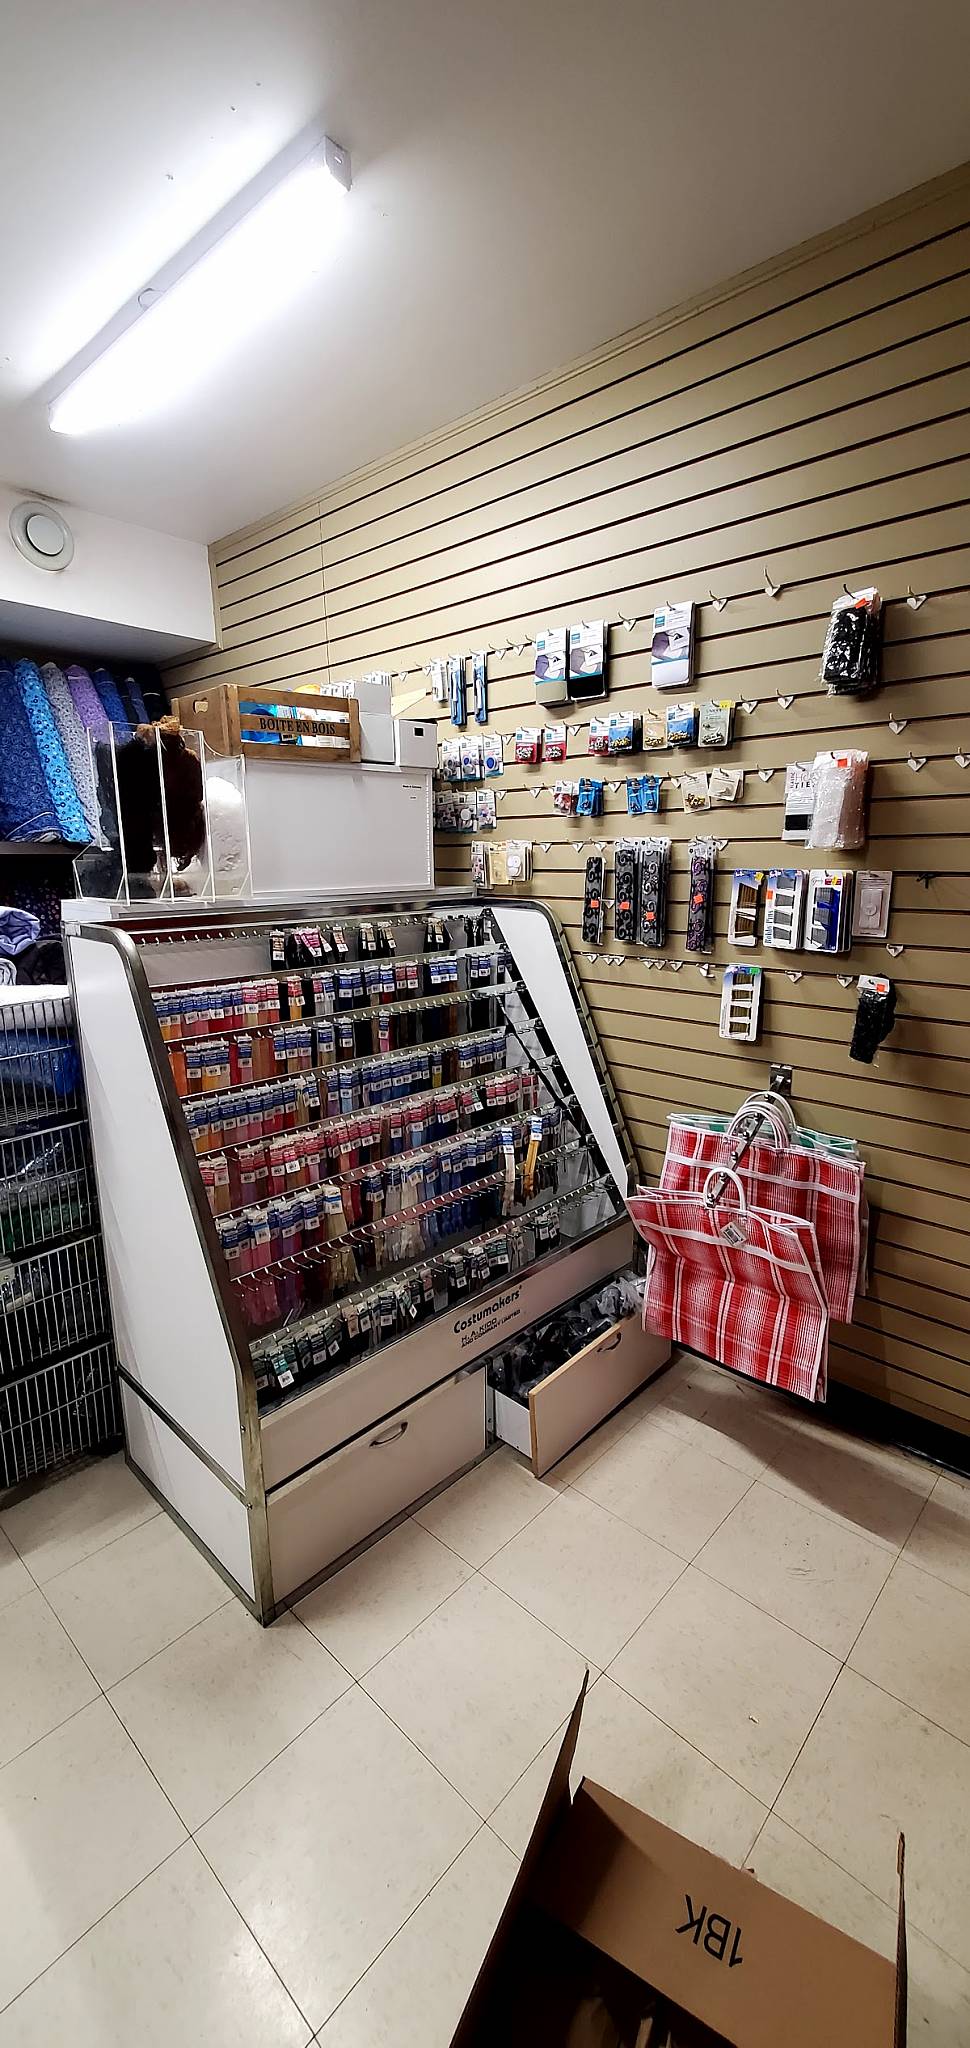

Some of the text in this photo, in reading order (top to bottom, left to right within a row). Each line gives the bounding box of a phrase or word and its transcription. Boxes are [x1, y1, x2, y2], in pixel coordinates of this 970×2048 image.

[259, 718, 336, 735] BOITE EN BOIS
[501, 1309, 521, 1325] LIMITED
[674, 1894, 744, 1968] 1BK
